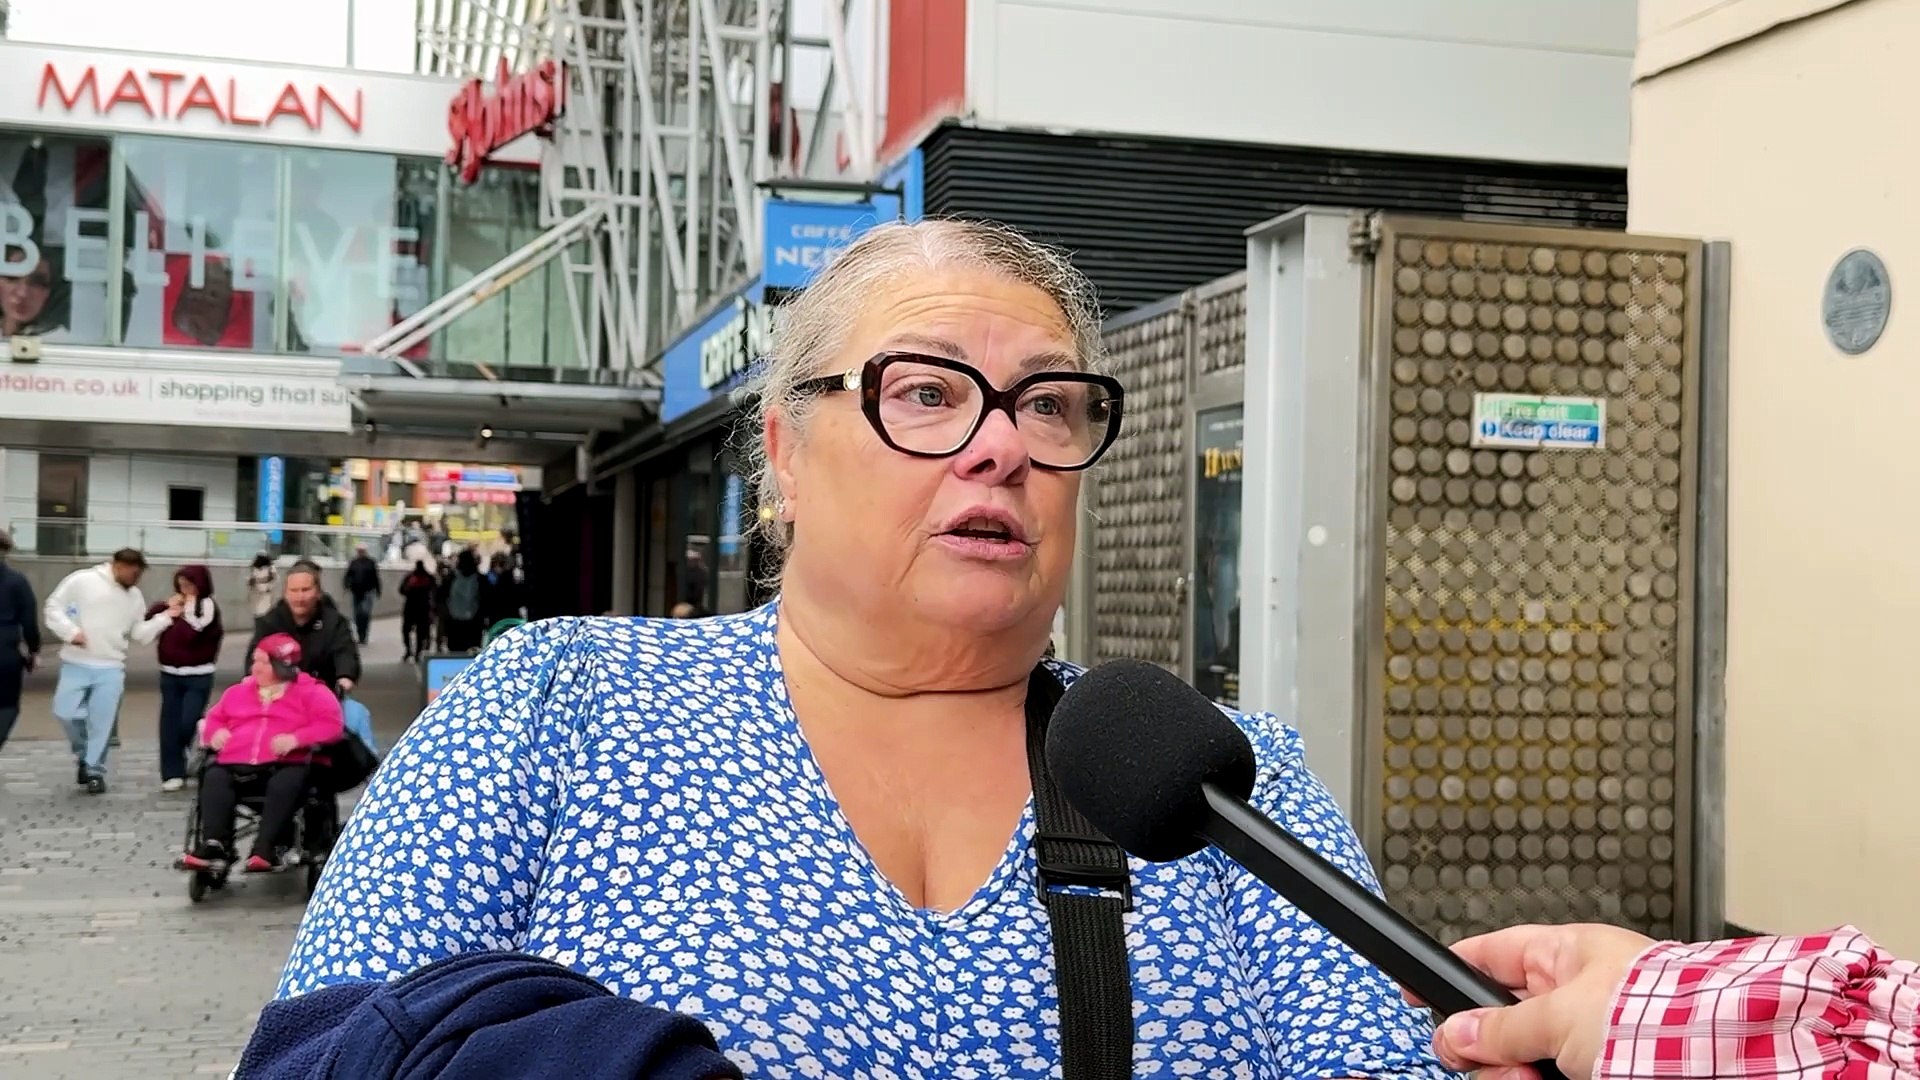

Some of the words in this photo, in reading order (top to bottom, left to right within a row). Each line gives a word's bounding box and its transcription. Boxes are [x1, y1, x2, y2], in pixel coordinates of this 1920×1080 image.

[38, 62, 363, 133] MATALAN
[0, 197, 420, 299] BELIEVE
[160, 380, 265, 407] shopping
[271, 383, 316, 404] that
[1537, 405, 1568, 419] exit
[1501, 420, 1544, 441] Keep
[1548, 421, 1592, 440] clear
